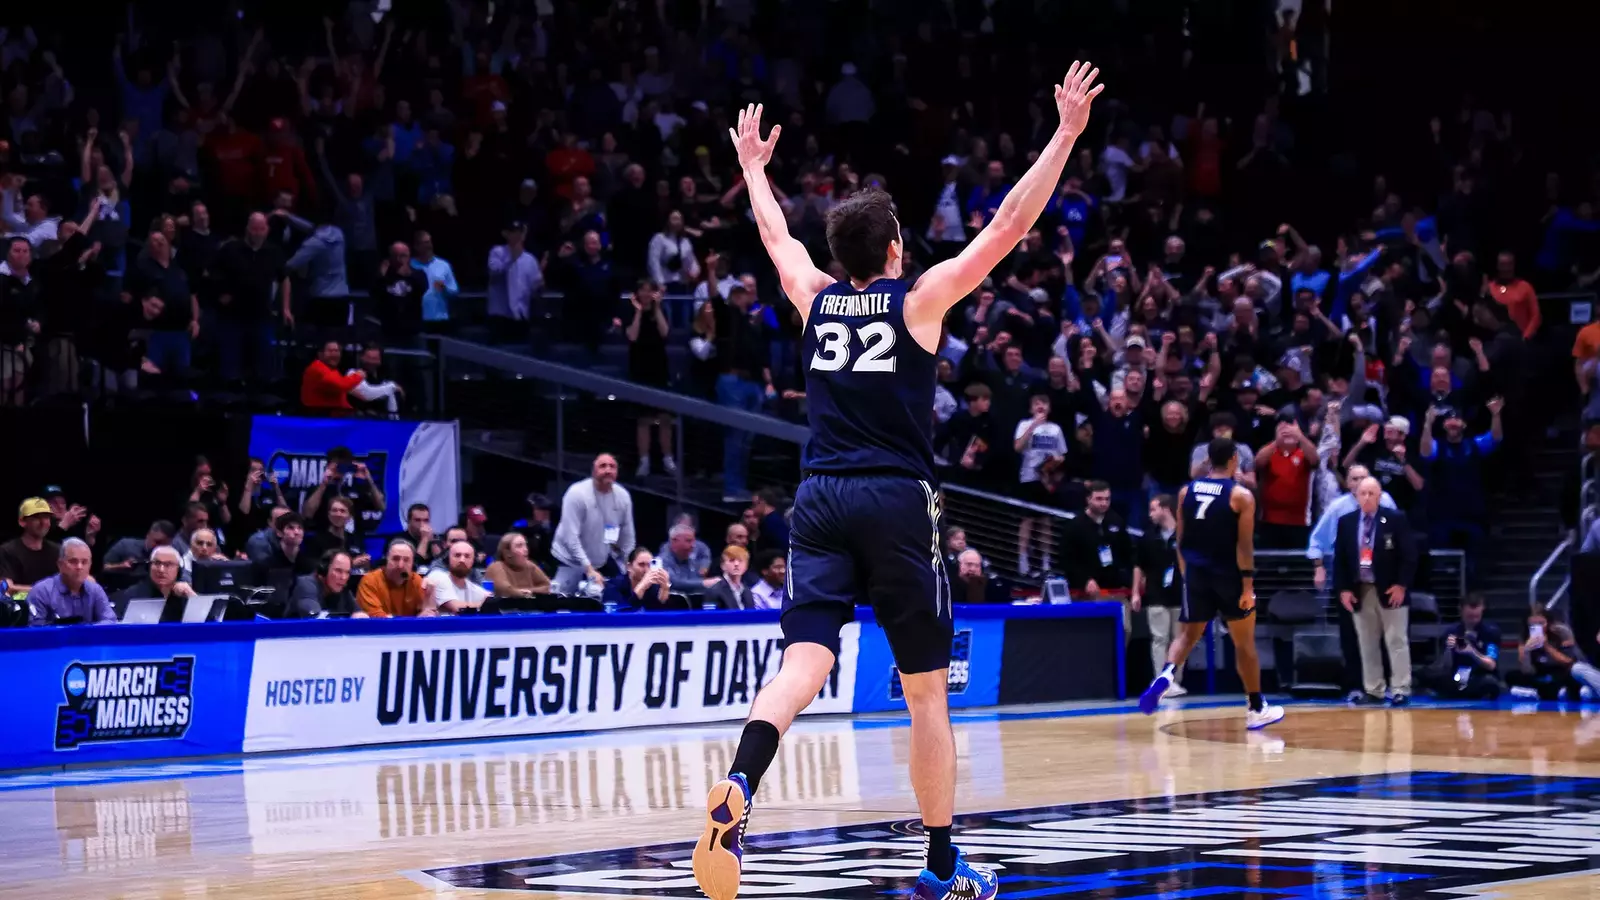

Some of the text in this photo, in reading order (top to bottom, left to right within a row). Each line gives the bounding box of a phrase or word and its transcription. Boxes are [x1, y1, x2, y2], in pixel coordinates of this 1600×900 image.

[820, 293, 892, 317] FREEMANTLE
[809, 321, 897, 373] 32
[1194, 494, 1216, 520] 7
[87, 665, 158, 698] MARCH
[265, 678, 336, 707] HOSTED
[341, 676, 365, 703] BY
[377, 642, 634, 726] UNIVERSITY
[643, 640, 694, 709] OF
[96, 695, 190, 730] MADNESS
